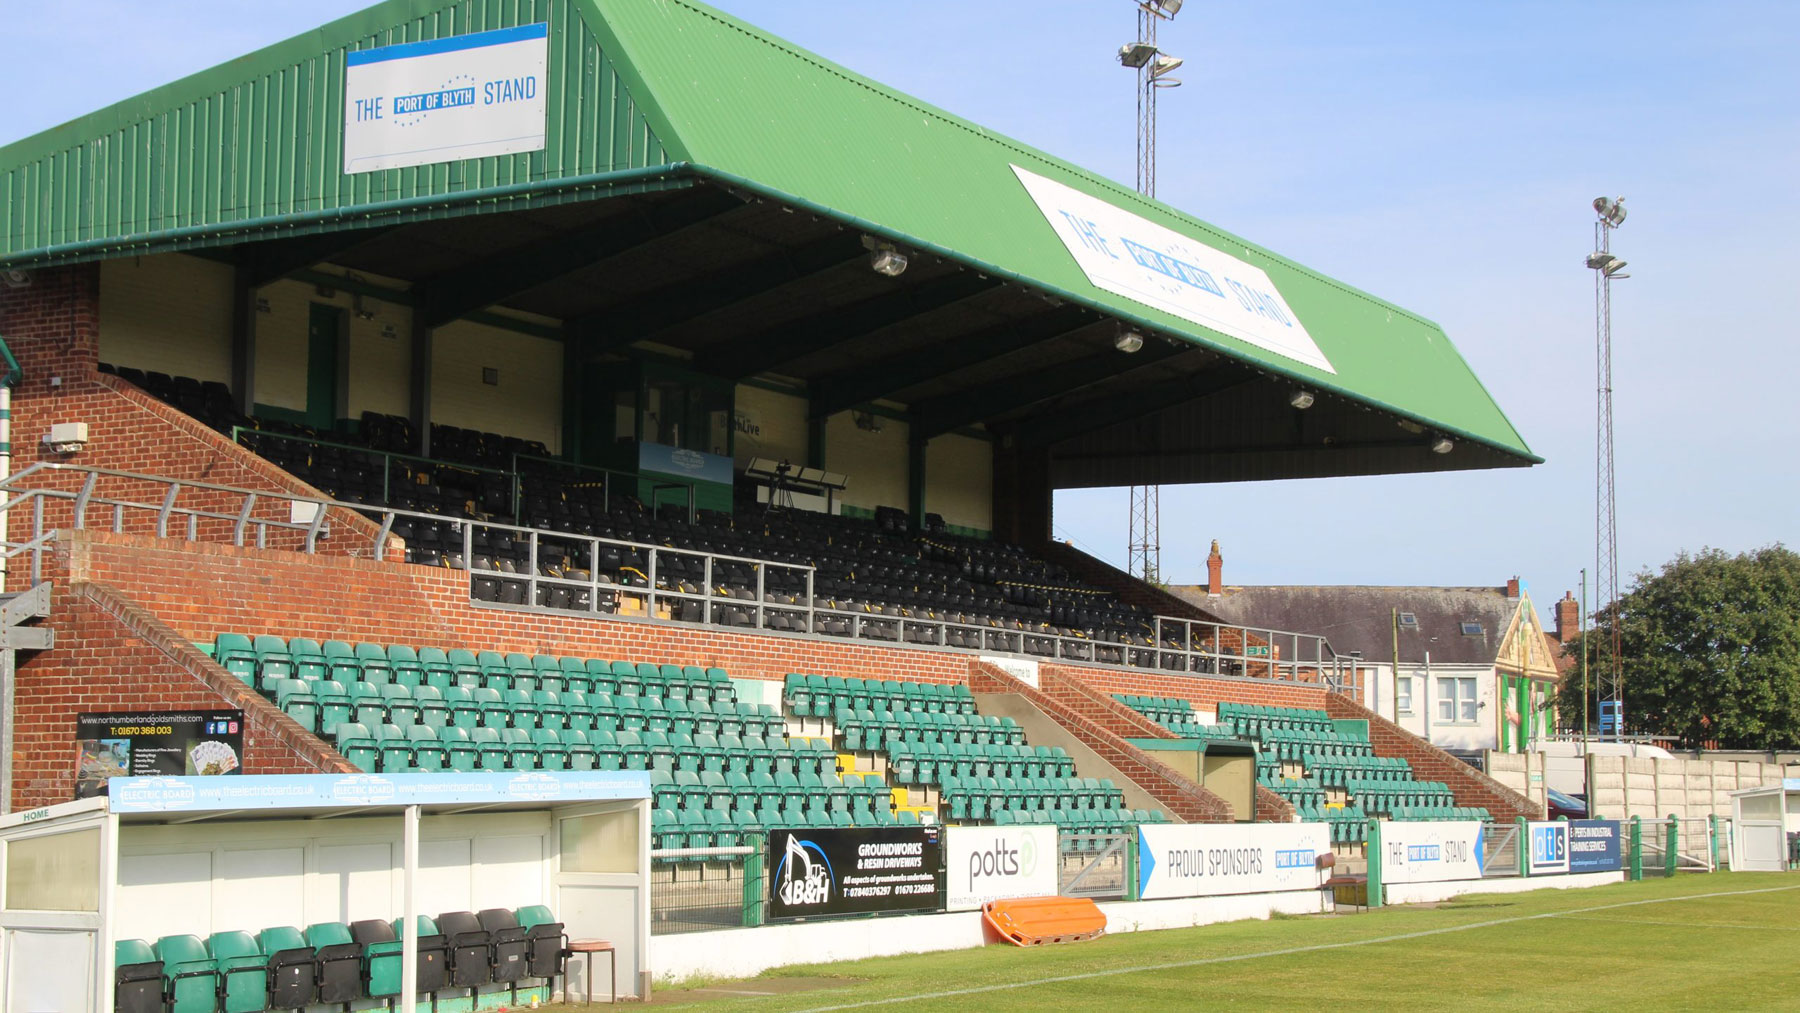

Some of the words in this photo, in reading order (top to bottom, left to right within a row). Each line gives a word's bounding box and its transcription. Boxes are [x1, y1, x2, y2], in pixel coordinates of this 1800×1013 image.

[355, 97, 383, 122] THE
[397, 96, 423, 113] PORT
[426, 94, 439, 109] OF
[442, 89, 472, 107] BLYTH
[484, 76, 536, 105] STAND
[1058, 210, 1119, 260] THE
[1224, 276, 1292, 327] STAND
[81, 714, 203, 726] www.northumberlandgoldsmiths.com
[110, 727, 118, 735] T:
[118, 727, 140, 735] 01670
[140, 727, 156, 735] 368
[156, 726, 172, 735] 003
[123, 790, 161, 800] ELECTRIC
[163, 789, 191, 799] BOARD
[199, 784, 315, 798] www.theelectricboard.co.uk
[24, 809, 49, 821] HOME
[858, 843, 923, 857] GROUNDWORKS
[1536, 831, 1563, 857] ots
[1388, 842, 1403, 866] THE
[1445, 840, 1467, 863] STAND
[857, 859, 864, 869] &
[864, 858, 884, 869] RESIN
[884, 857, 922, 868] DRIVEWAYS
[969, 838, 1019, 893] potts
[1168, 849, 1204, 878] PROUD
[1208, 848, 1263, 877] SPONSORS
[843, 876, 851, 884] All
[851, 876, 870, 885] aspects
[870, 875, 876, 883] of
[875, 873, 906, 885] groundworks
[792, 879, 830, 904] B&H
[895, 885, 913, 895] 01670
[913, 883, 935, 894] 226686
[949, 896, 977, 905] PRINTING
